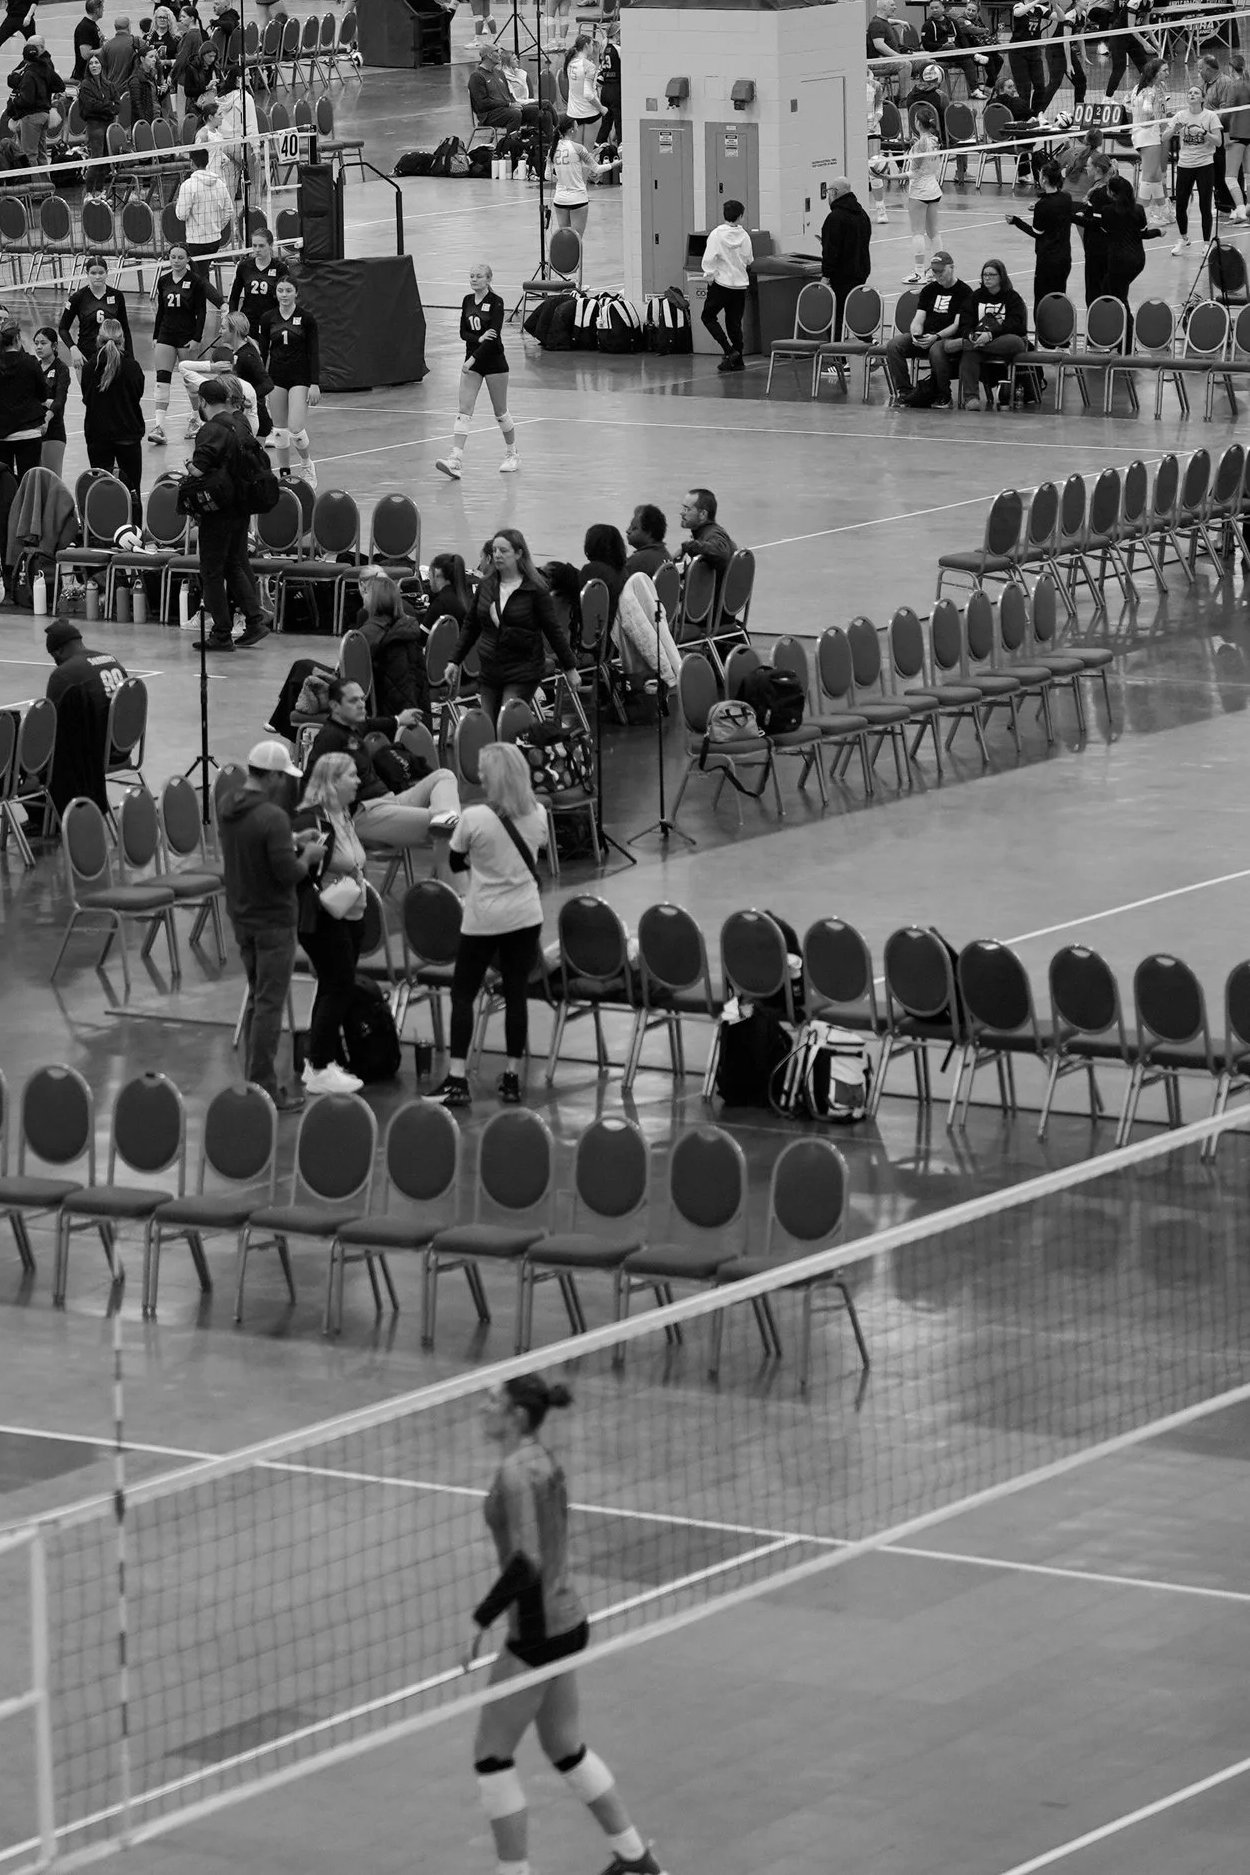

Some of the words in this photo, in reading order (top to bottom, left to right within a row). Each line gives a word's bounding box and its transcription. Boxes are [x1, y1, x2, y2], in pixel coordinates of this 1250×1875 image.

[1075, 105, 1094, 124] 00
[1102, 105, 1121, 124] 00
[281, 134, 298, 157] 40
[555, 150, 570, 166] 22
[251, 280, 268, 295] 29
[167, 293, 181, 307] 21
[96, 310, 105, 324] 6
[468, 316, 481, 331] 10
[281, 330, 288, 345] 1
